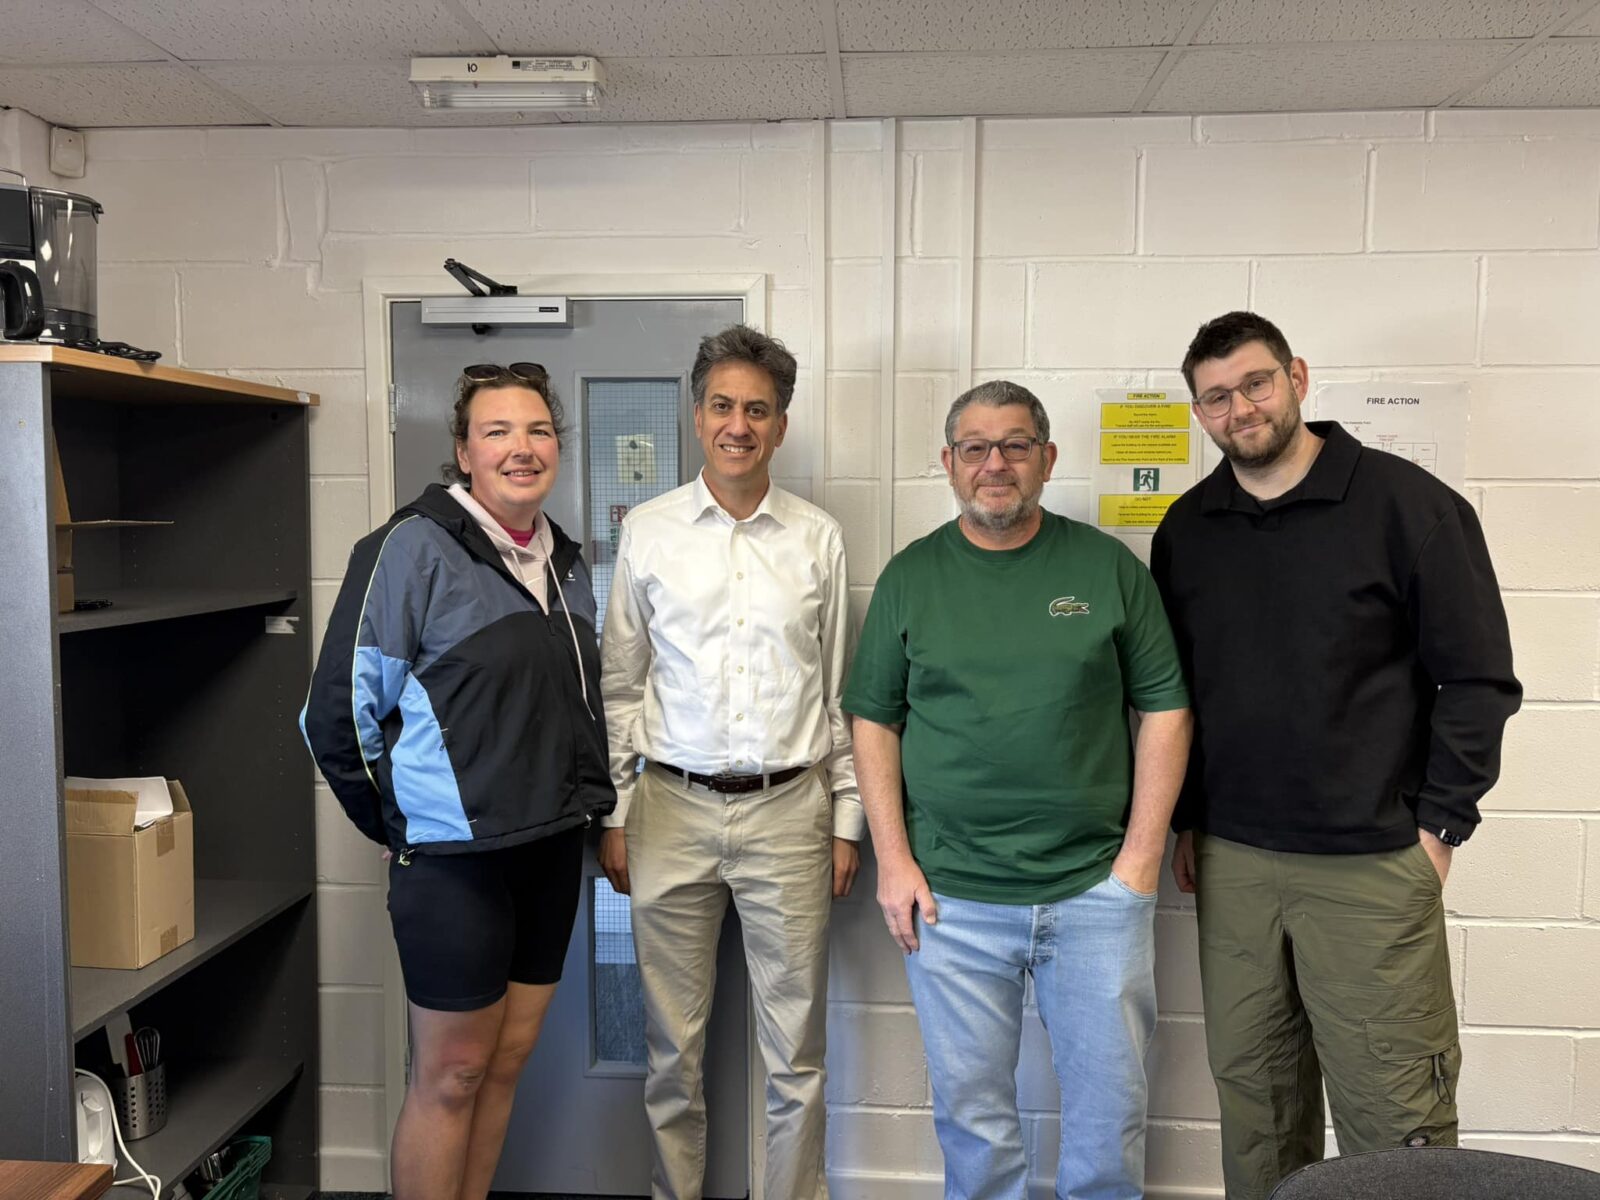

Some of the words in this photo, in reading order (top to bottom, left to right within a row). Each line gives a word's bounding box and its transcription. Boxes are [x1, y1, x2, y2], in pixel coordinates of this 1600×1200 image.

[467, 62, 478, 73] 10
[1366, 397, 1386, 405] FIRE
[1387, 397, 1420, 405] ACTION
